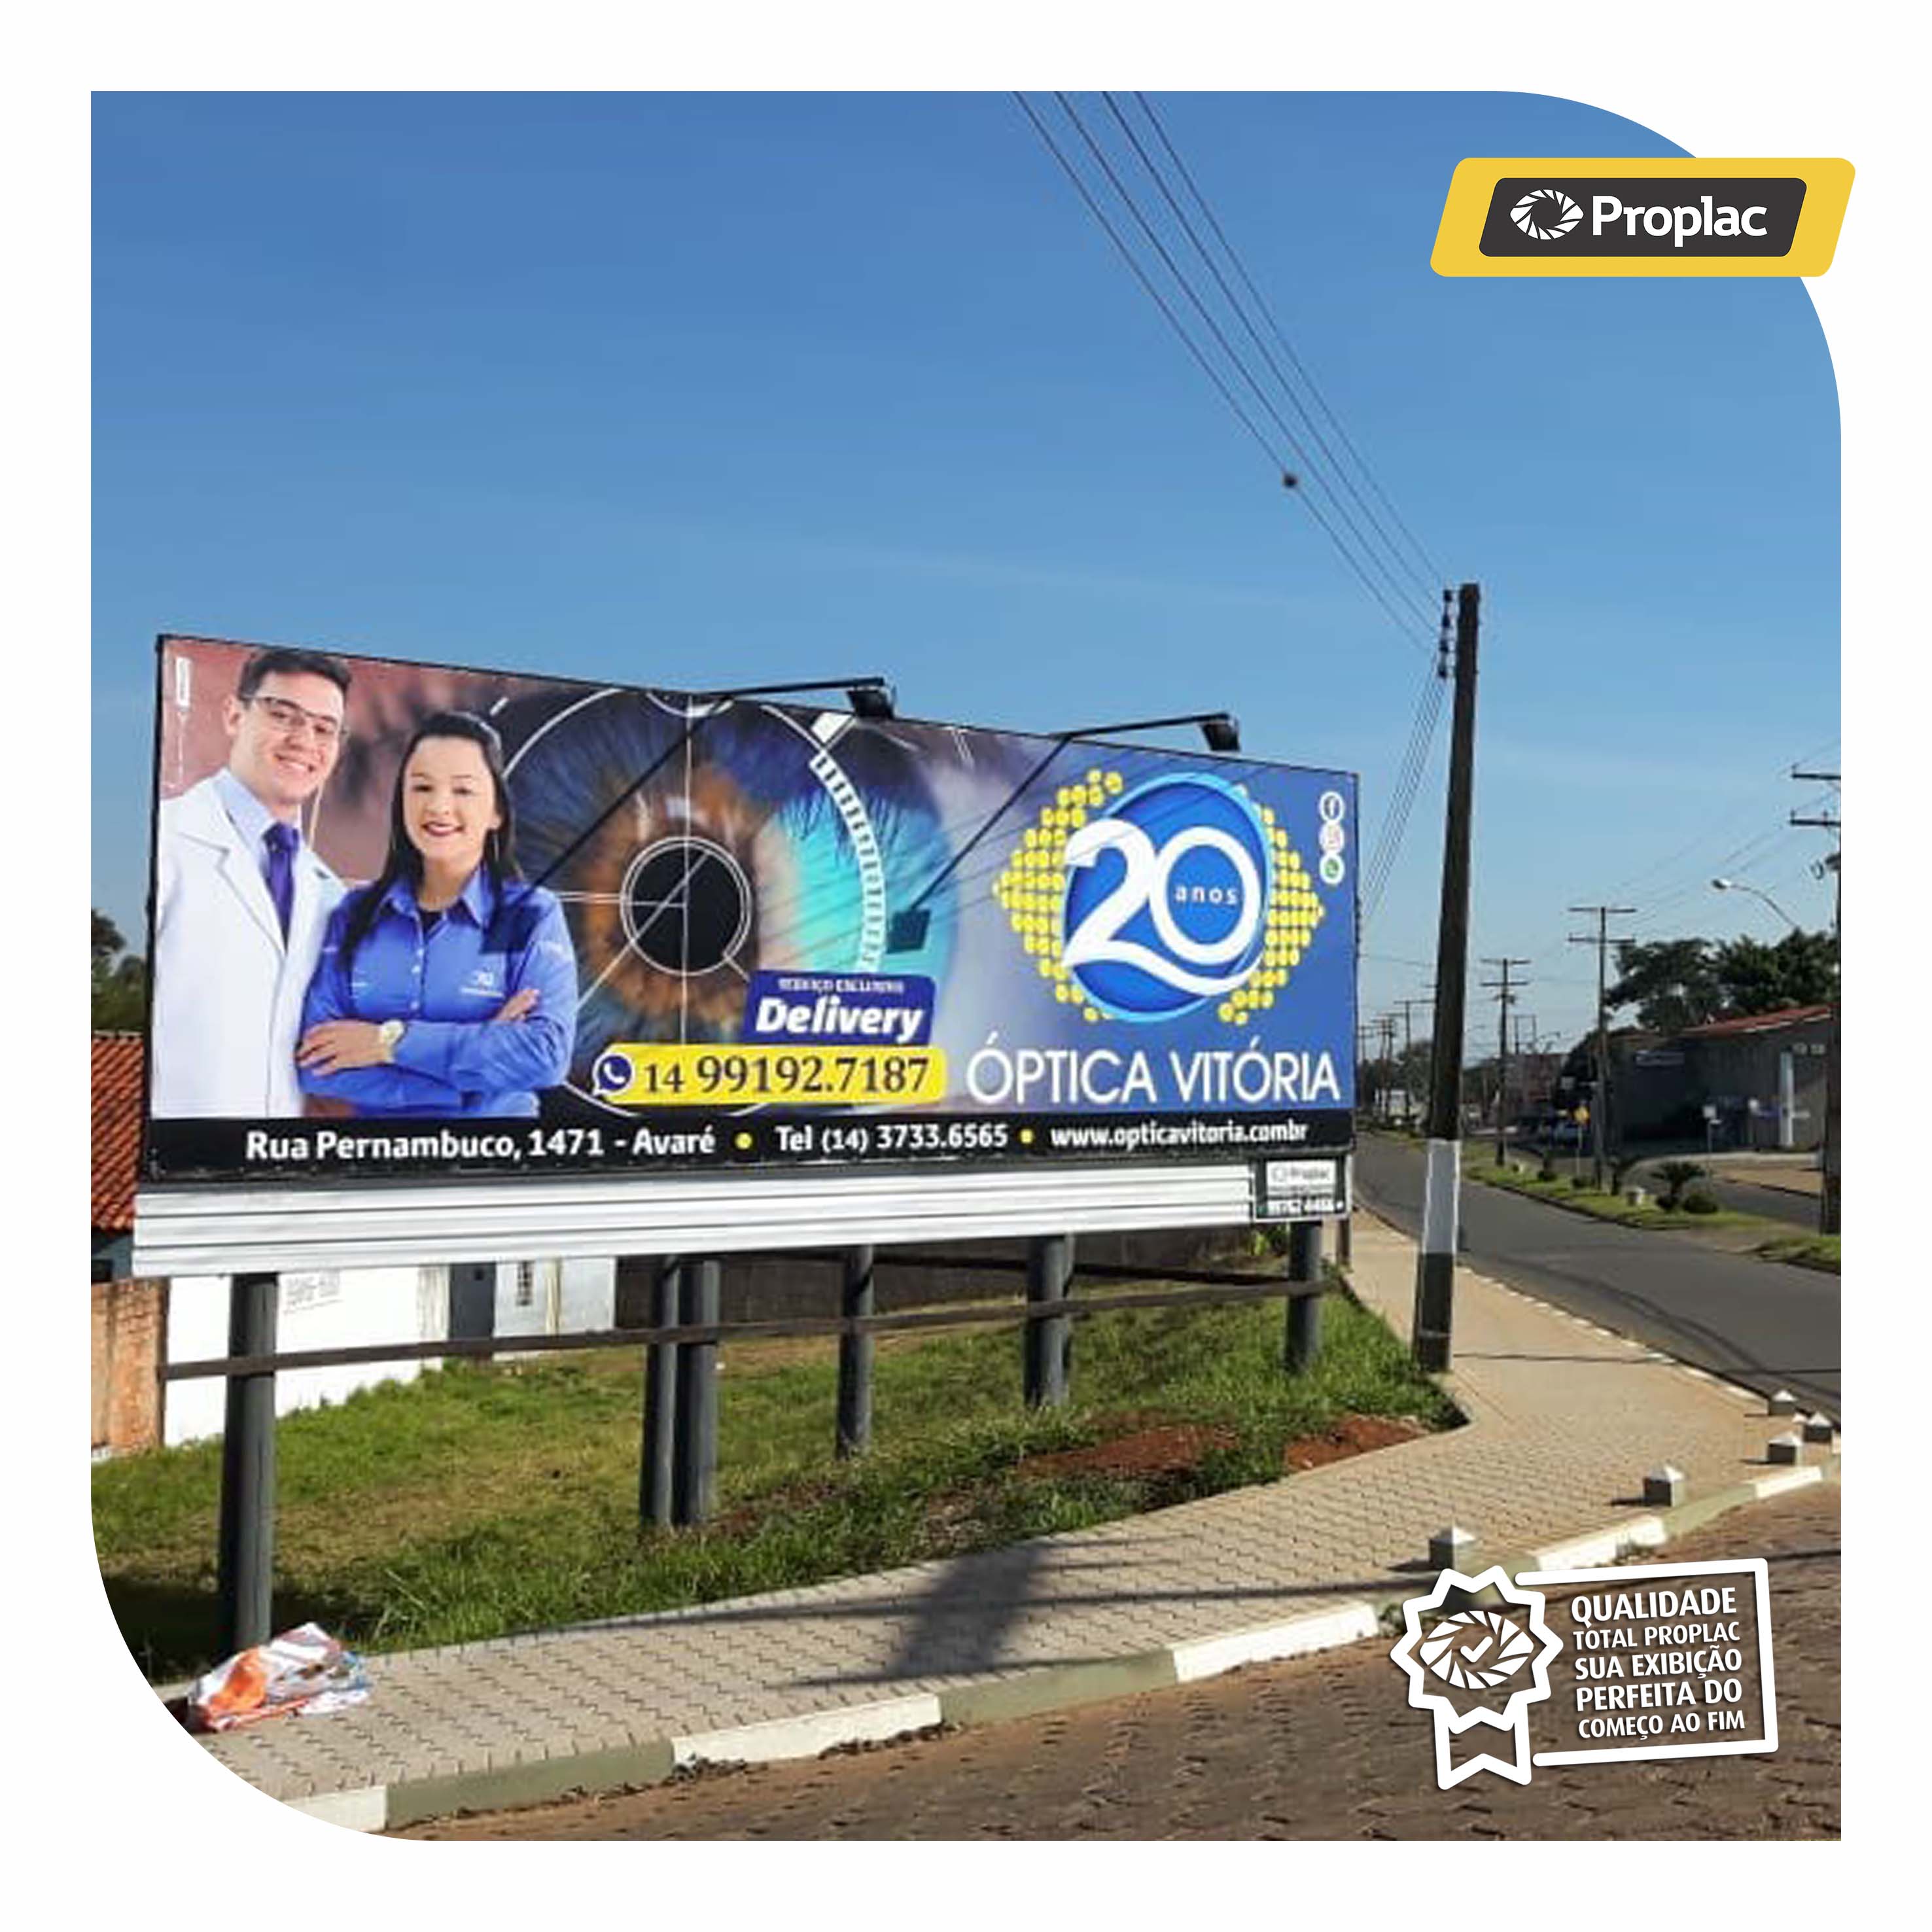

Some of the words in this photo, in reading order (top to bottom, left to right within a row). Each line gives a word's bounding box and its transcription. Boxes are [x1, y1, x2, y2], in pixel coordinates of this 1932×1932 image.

[1062, 818, 1261, 994] 20
[1175, 886, 1238, 905] anos
[756, 994, 924, 1043] Delivery
[644, 1064, 684, 1093] 14
[697, 1055, 929, 1093] 99192.7187
[966, 1031, 1157, 1104] ÓPTICA
[1170, 1035, 1341, 1102] VITÓRIA
[246, 1130, 309, 1159] Rua
[316, 1128, 521, 1161] Pernambuco,
[528, 1129, 605, 1156] 1471
[632, 1124, 716, 1155] Avaré
[775, 1125, 813, 1151] Tel
[822, 1128, 868, 1153] (14)
[875, 1122, 1008, 1149] 3733.6565
